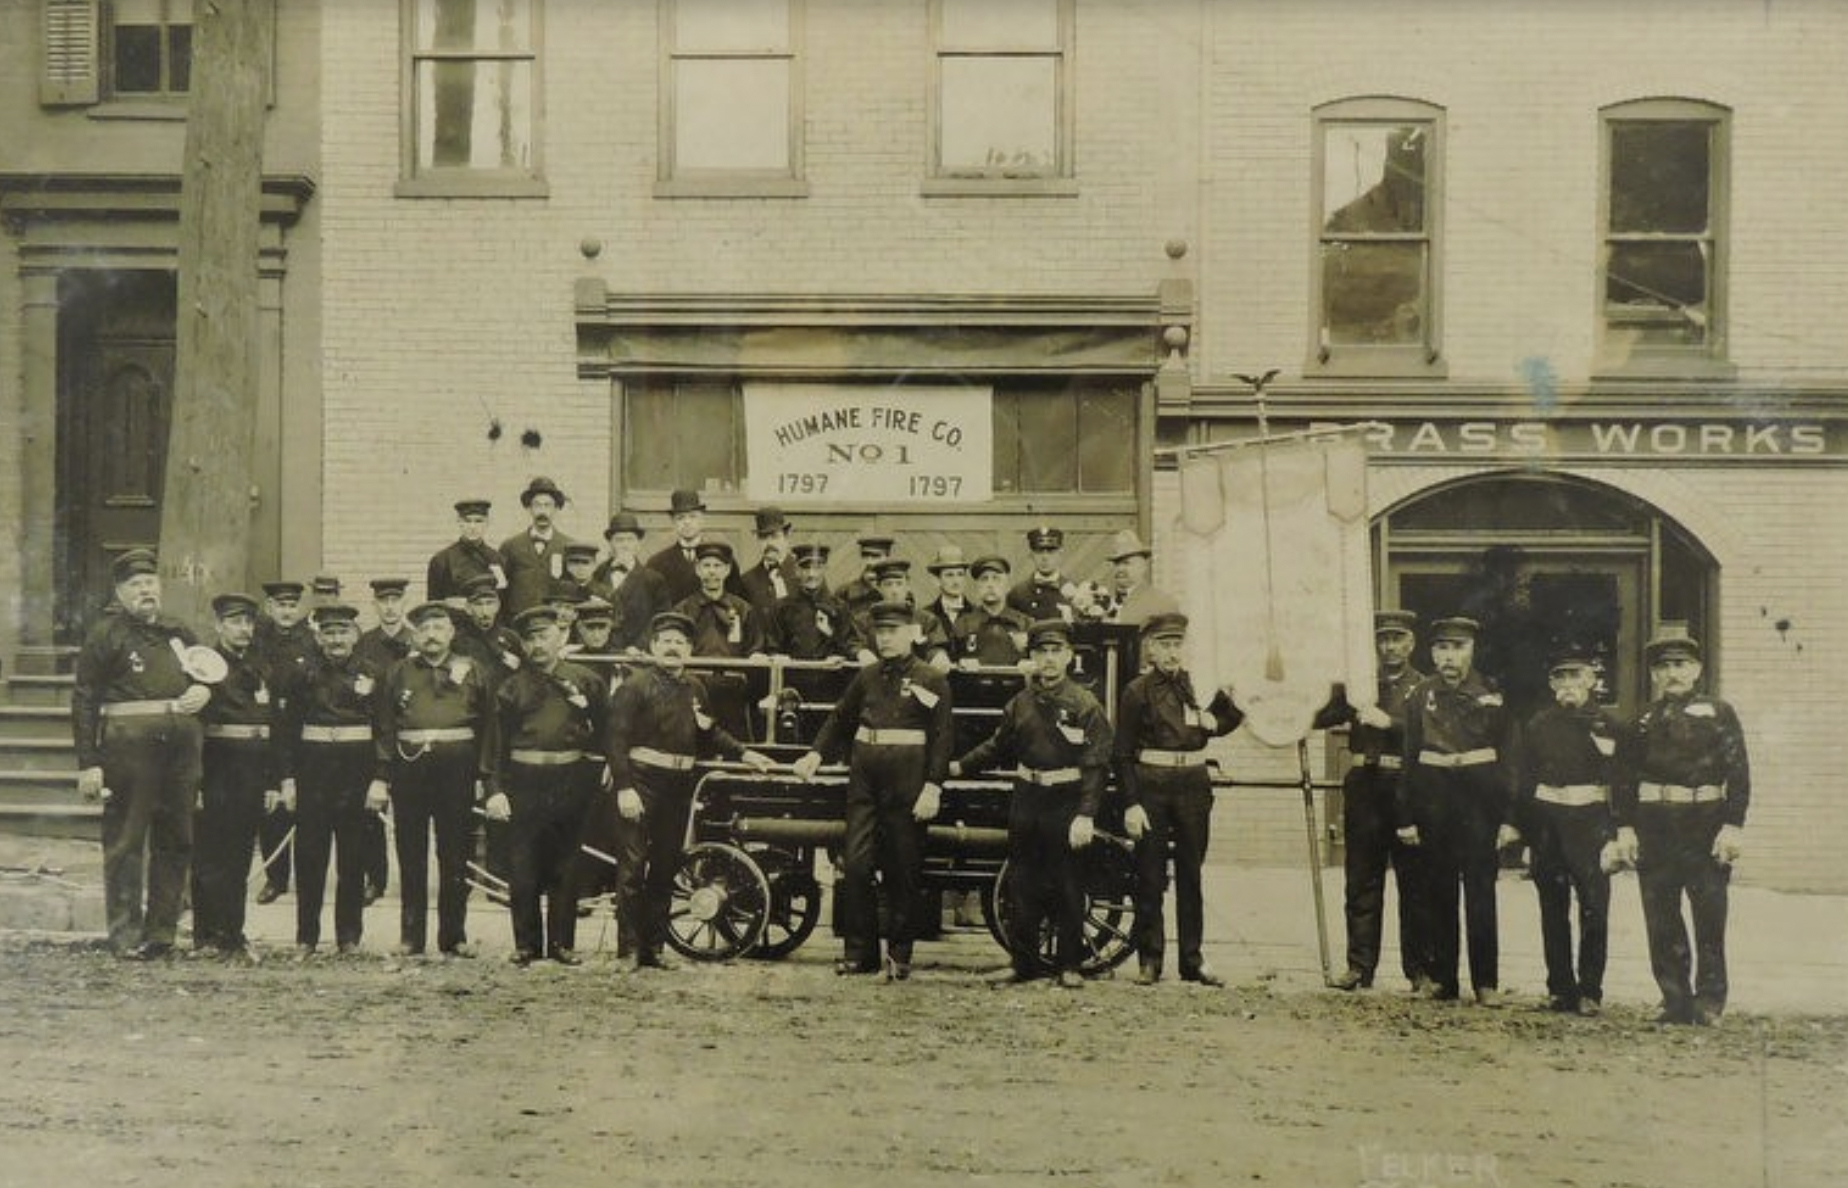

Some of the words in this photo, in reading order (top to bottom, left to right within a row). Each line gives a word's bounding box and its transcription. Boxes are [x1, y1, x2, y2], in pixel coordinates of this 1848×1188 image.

[775, 407, 861, 447] HUMANE
[871, 407, 921, 434] FIRE
[1591, 424, 1825, 453] WORKS
[894, 445, 913, 464] 1
[778, 473, 829, 494] 1797
[909, 476, 962, 497] 1797
